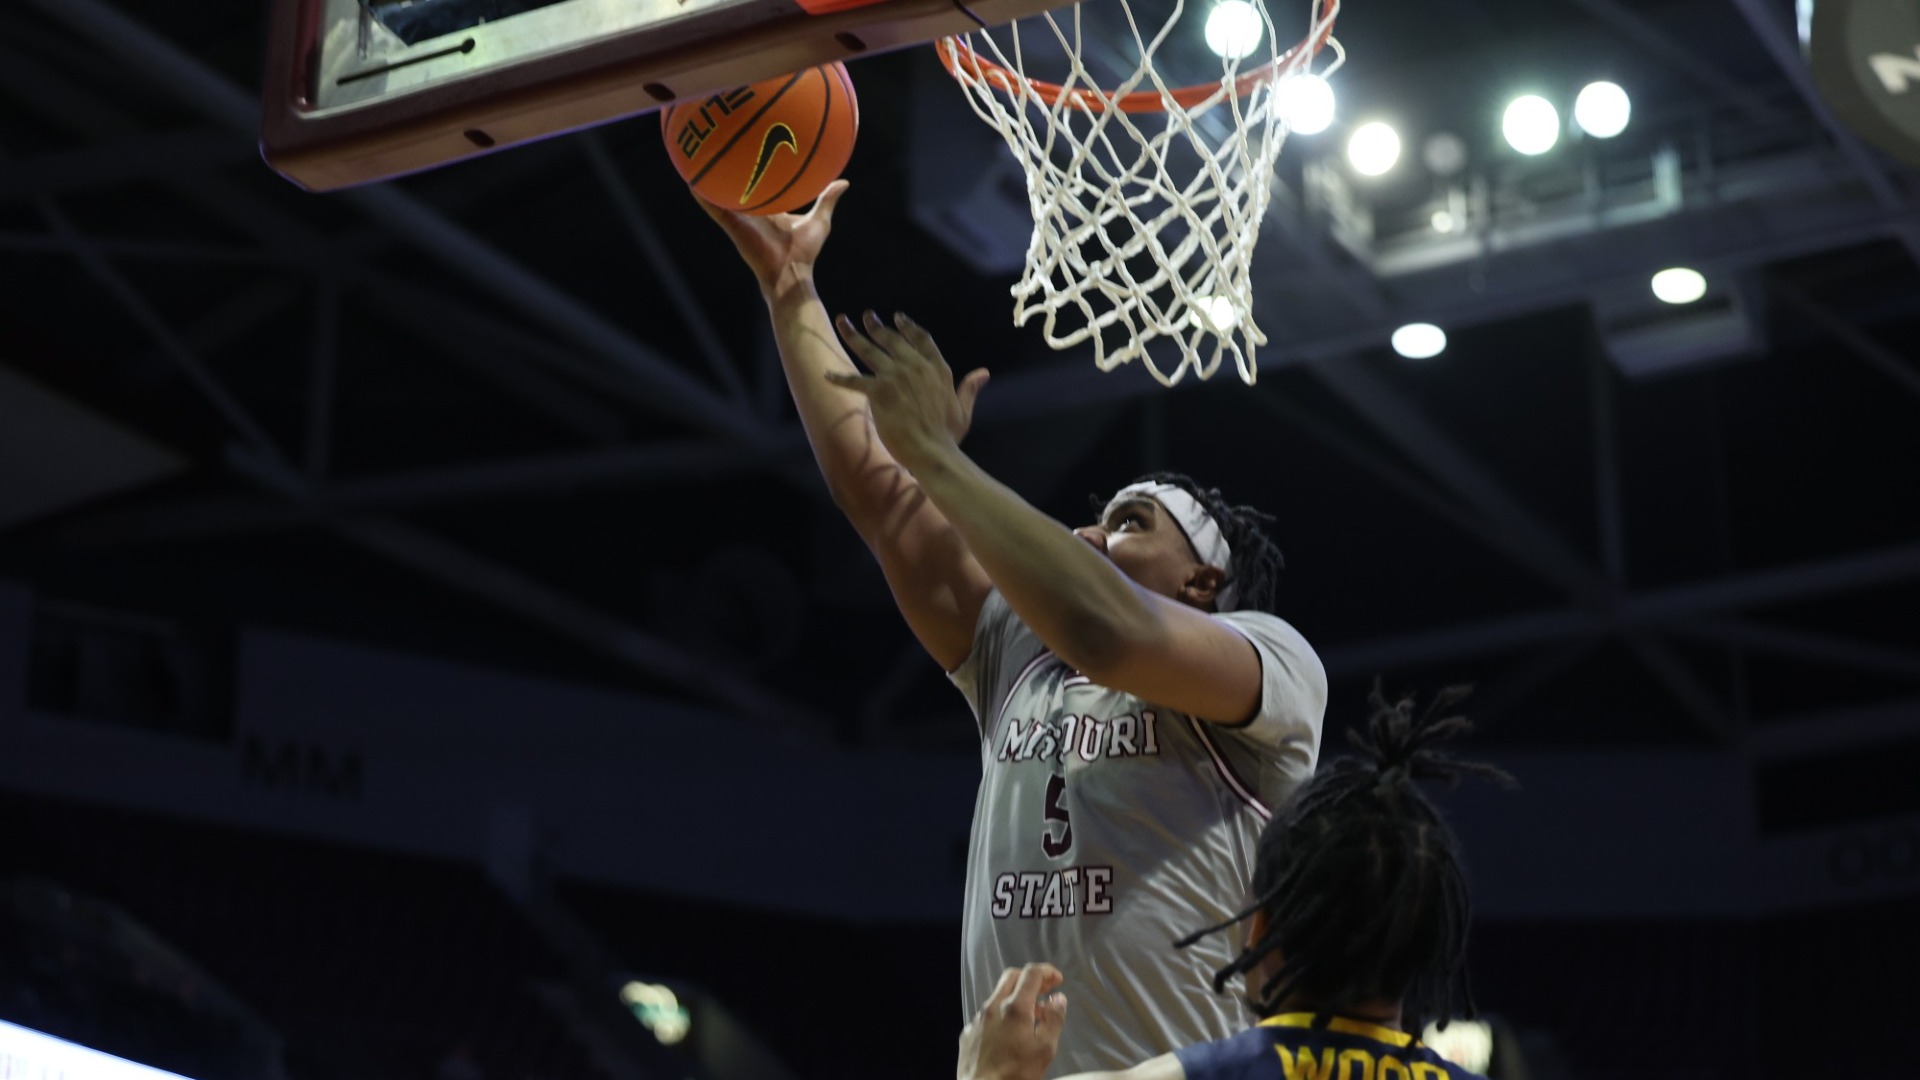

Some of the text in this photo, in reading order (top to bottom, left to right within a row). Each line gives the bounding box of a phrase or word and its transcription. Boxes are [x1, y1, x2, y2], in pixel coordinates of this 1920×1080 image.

[677, 85, 755, 160] ELITE
[998, 711, 1160, 763] MISOURI
[1041, 771, 1073, 860] 5
[992, 865, 1114, 917] STATE
